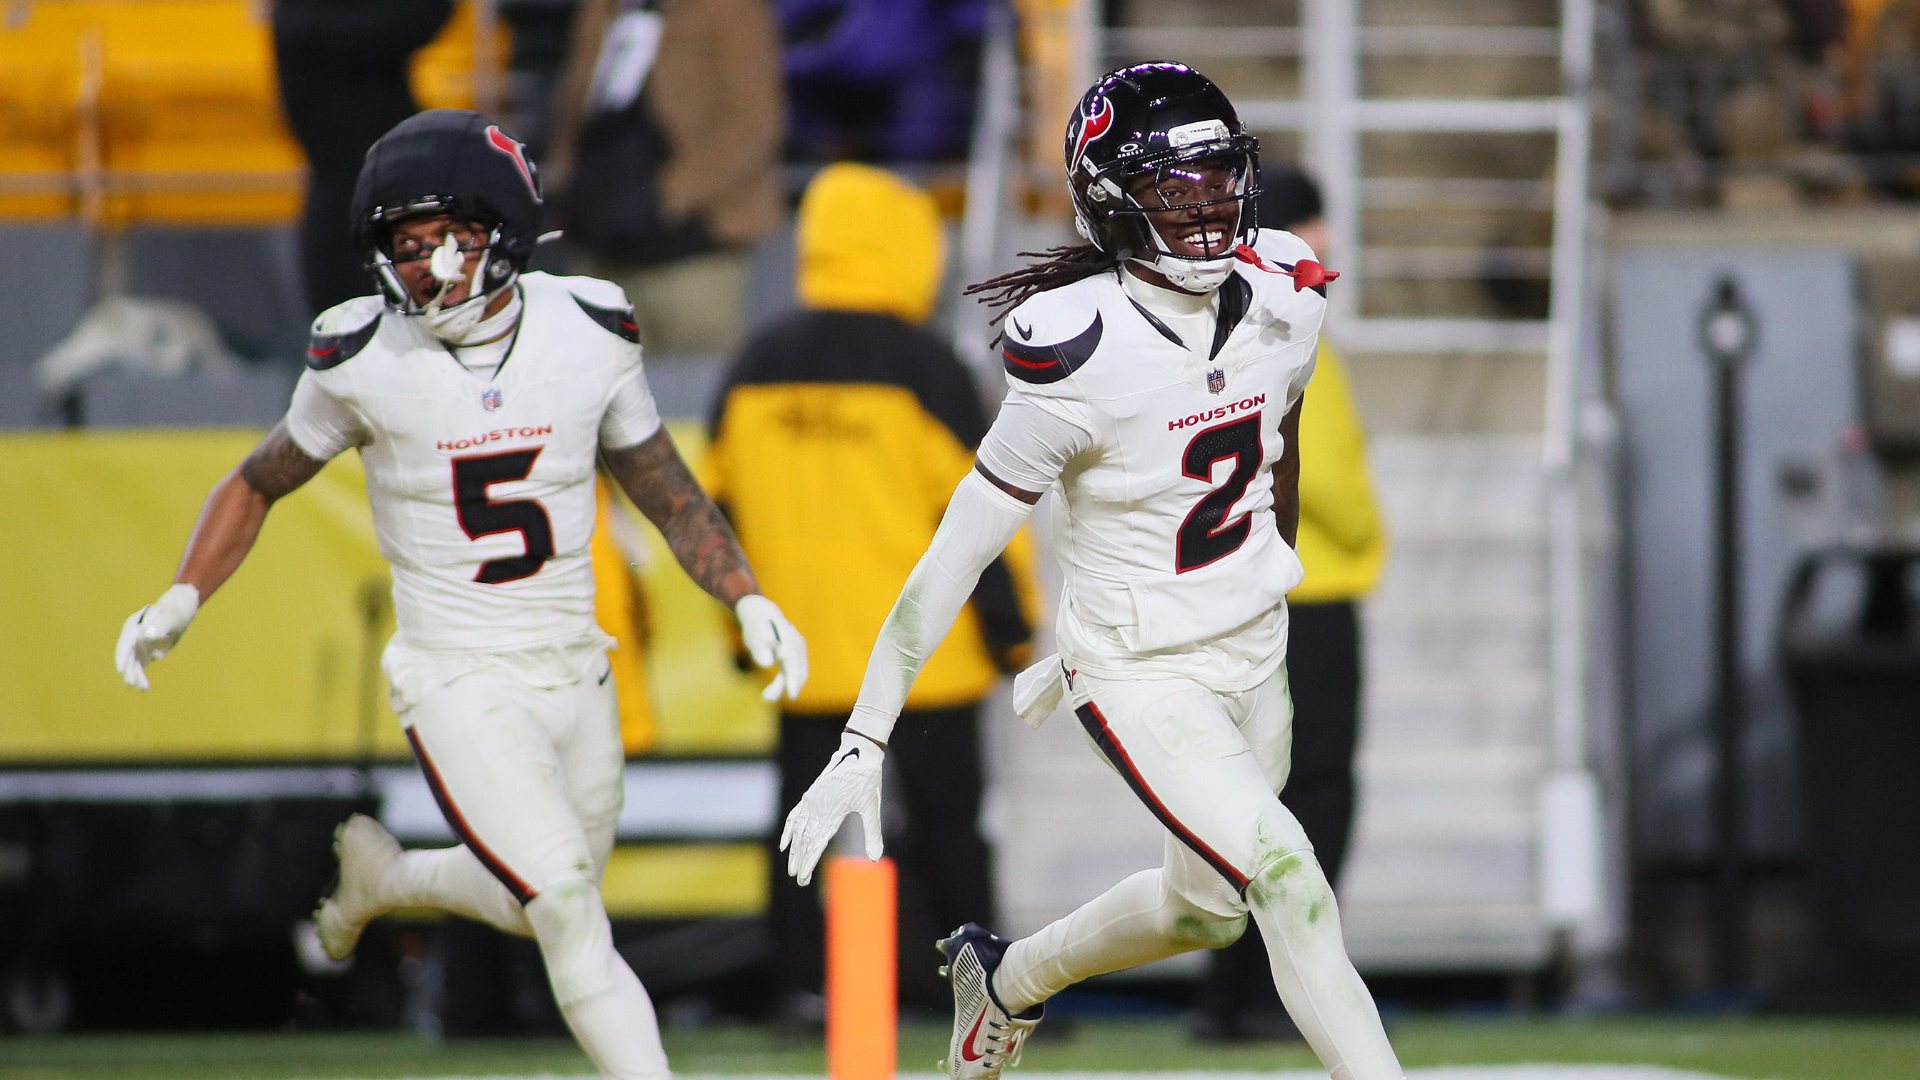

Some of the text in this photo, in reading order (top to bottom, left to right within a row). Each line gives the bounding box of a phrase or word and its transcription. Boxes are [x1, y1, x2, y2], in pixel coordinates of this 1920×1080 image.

[1117, 148, 1144, 159] OAKLEY
[1168, 393, 1266, 431] HOUSTON
[437, 425, 553, 450] HOUSTON
[1175, 410, 1263, 575] 2
[451, 444, 556, 585] 5
